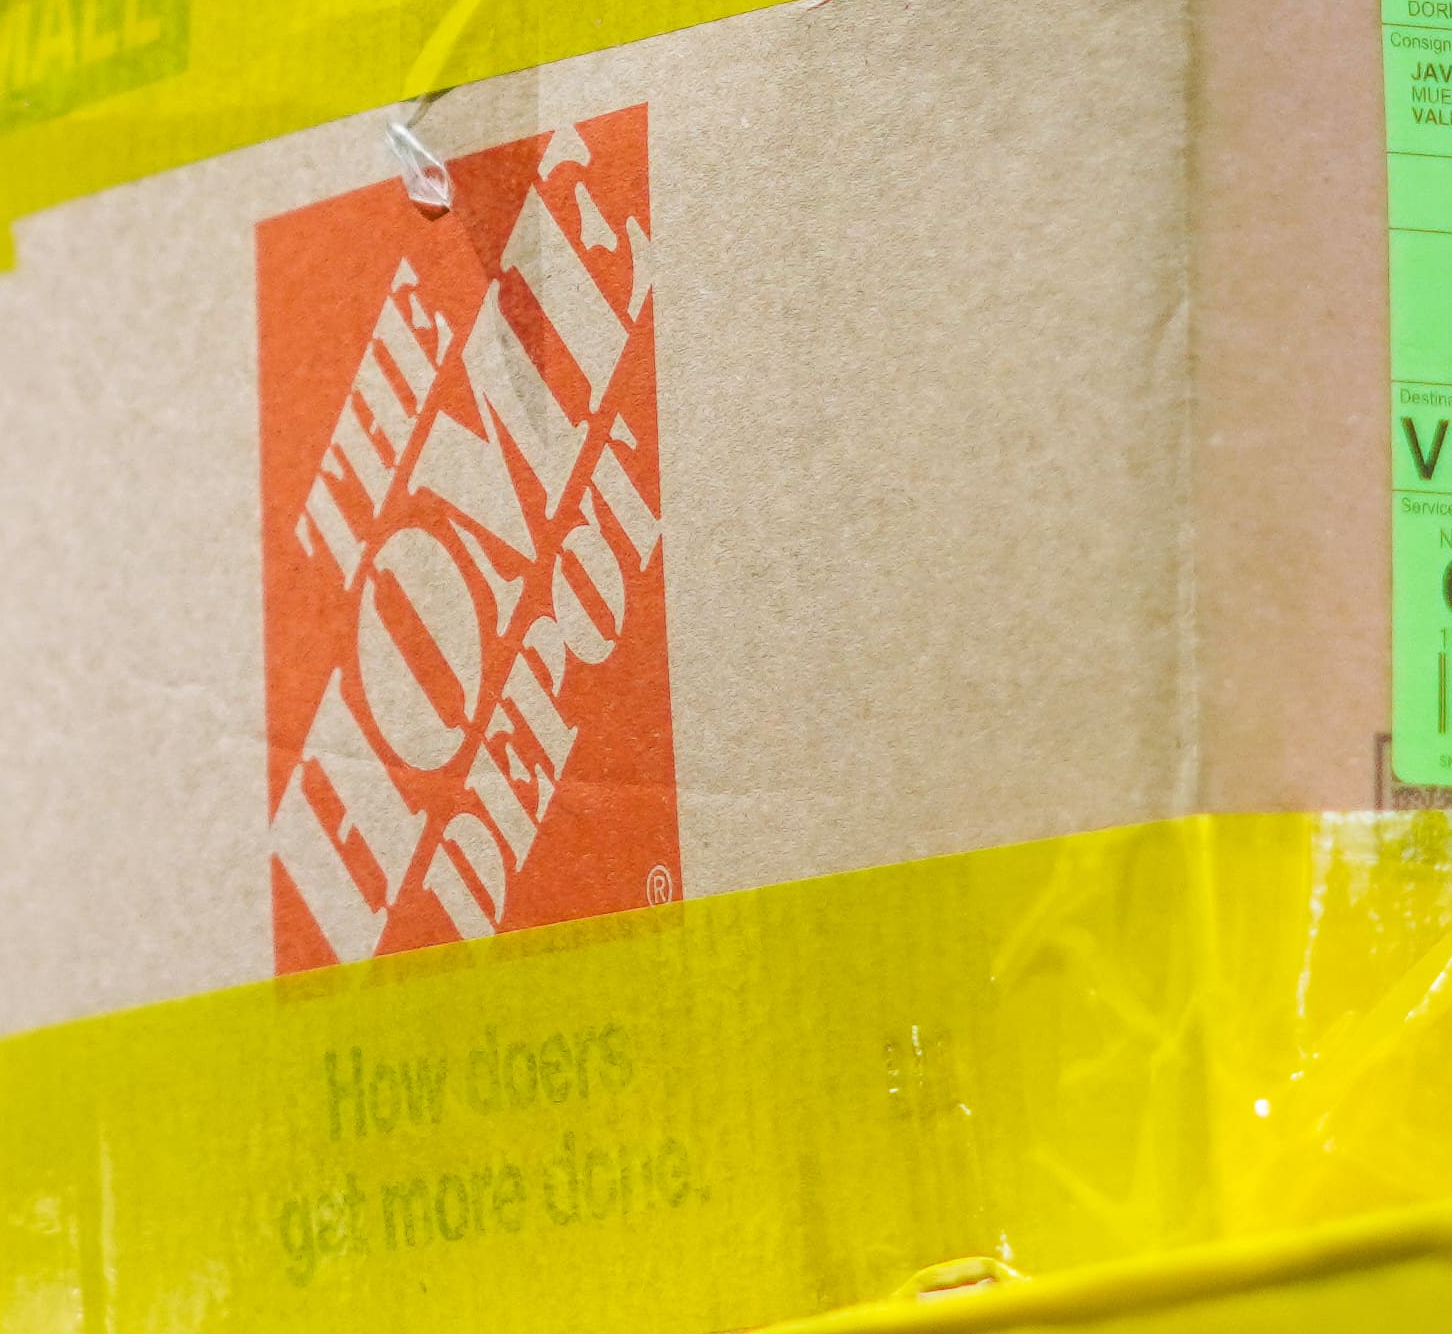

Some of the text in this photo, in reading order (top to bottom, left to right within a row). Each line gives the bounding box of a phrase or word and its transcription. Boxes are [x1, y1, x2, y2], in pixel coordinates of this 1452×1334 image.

[270, 126, 652, 977] HOME
[295, 256, 454, 591] THE
[423, 412, 664, 939] DEPOT
[278, 1130, 712, 1289] get more done.
[324, 1022, 635, 1142] How doers
